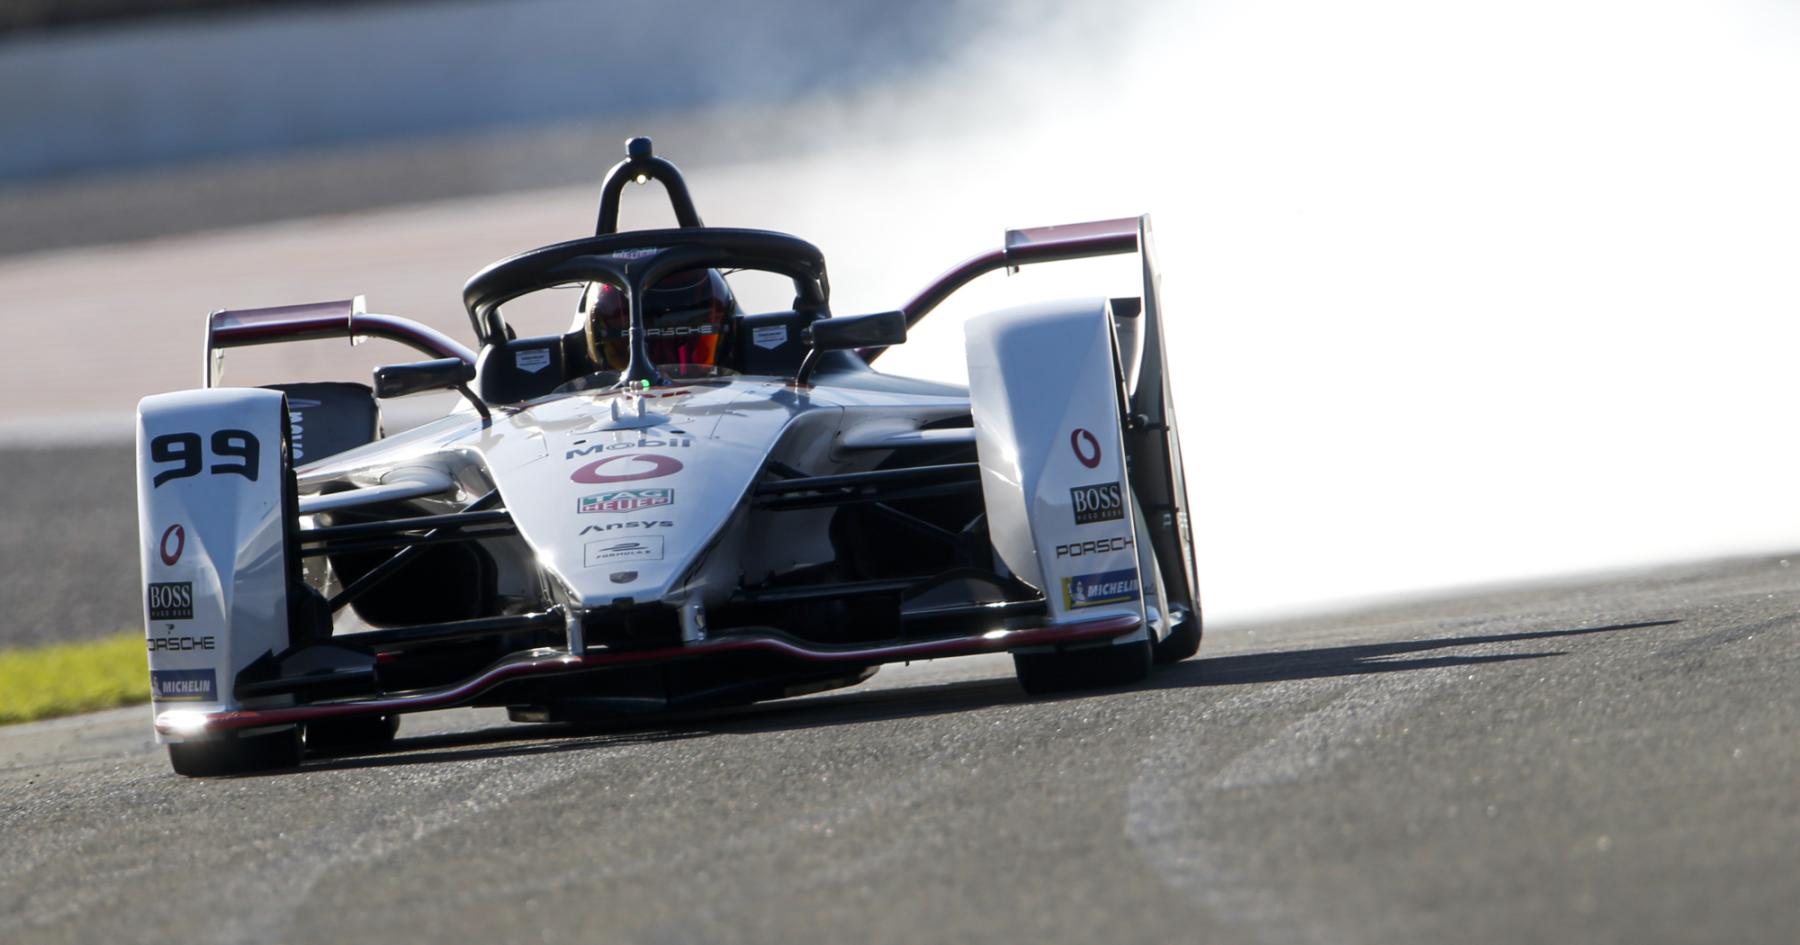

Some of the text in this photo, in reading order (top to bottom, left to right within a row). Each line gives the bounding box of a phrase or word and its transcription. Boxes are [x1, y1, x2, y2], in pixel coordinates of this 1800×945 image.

[621, 324, 713, 337] PRSCHE
[151, 428, 260, 489] 99
[566, 438, 691, 460] Mobil
[1073, 485, 1121, 513] BOSS
[579, 520, 674, 536] Ansys
[1056, 536, 1136, 559] PORSCH
[151, 584, 191, 609] BOSS
[162, 680, 211, 694] MICHELIN
